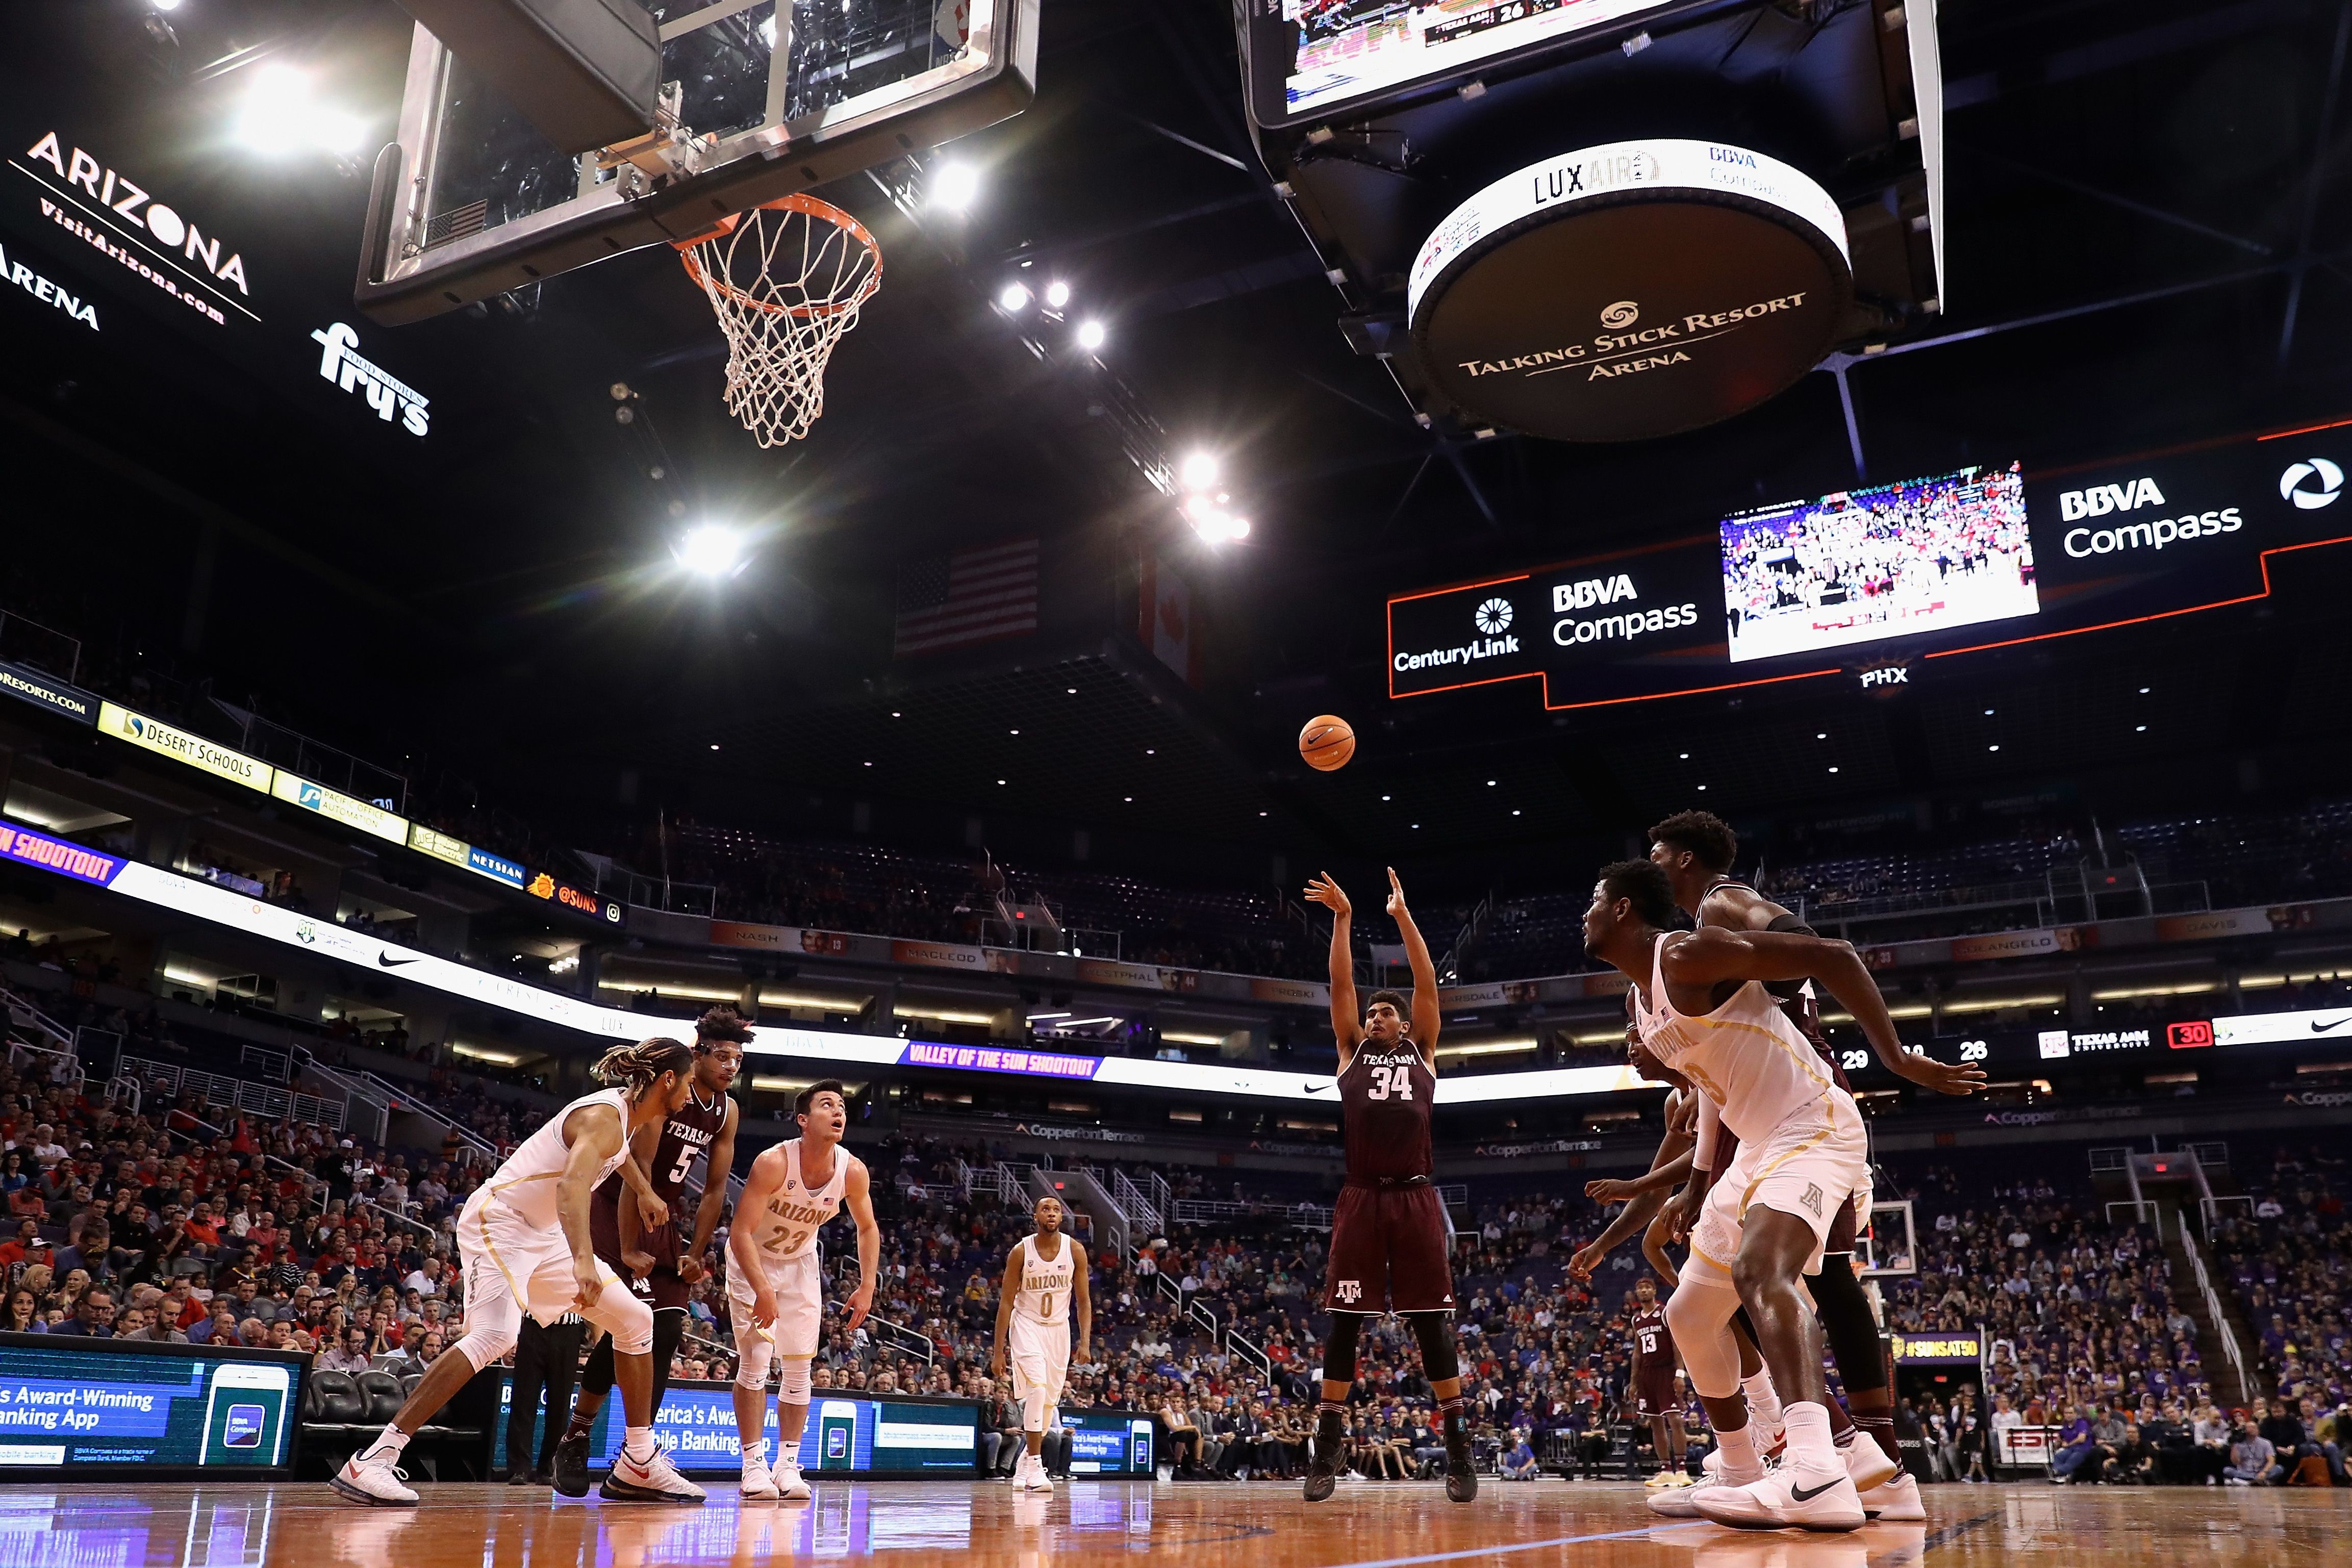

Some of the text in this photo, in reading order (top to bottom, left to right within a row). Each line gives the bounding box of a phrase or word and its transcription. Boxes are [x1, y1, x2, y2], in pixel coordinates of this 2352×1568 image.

[1500, 3, 1524, 22] 26
[27, 132, 248, 296] ARIZONA
[40, 197, 225, 325] VisitArizona.com
[1459, 291, 1807, 377] TALKING STICK RESORT
[310, 322, 430, 437] fry's
[343, 349, 424, 405] FOOD STORES
[1587, 351, 1692, 382] ARENA
[2060, 477, 2166, 522] BBVA
[2064, 508, 2242, 560] Compass
[1553, 574, 1637, 613] BBVA
[1553, 602, 1698, 646] Compass
[1394, 634, 1520, 672] CenturyLink
[1860, 668, 1909, 689] PHX
[147, 724, 195, 755] DESERT
[197, 745, 252, 777] SCHOOLS
[323, 802, 377, 827] AUTOMATION
[324, 791, 354, 809] PACIFIC
[357, 804, 384, 820] OFFICE
[13, 833, 114, 881] SHOOTOUT
[472, 853, 522, 879] NETSIAN
[559, 887, 597, 914] @SUNS
[736, 931, 778, 942] NASH
[907, 948, 975, 963] MACLEOD
[1449, 991, 1500, 1002] ARSDALE
[2072, 1032, 2117, 1047] TEXAS
[2179, 1025, 2207, 1043] 30
[909, 1044, 1095, 1076] VALLEY OF THE SUN SHOOTOUT
[1363, 1053, 1417, 1068] TEXAS A&M
[1842, 1050, 1868, 1070] 29
[1960, 1040, 1988, 1061] 26
[1368, 1067, 1413, 1101] 34
[667, 1120, 703, 1145] TEXAS
[669, 1145, 699, 1183] 5
[762, 1225, 810, 1255] 23
[1025, 1275, 1069, 1291] ARIZONA
[1041, 1292, 1053, 1318] 0
[1640, 1333, 1658, 1354] 13
[1906, 1340, 1978, 1357] #SUNSAT50
[15, 1386, 155, 1412] Award-Winning
[61, 1409, 99, 1430] App
[681, 1430, 740, 1455] Banking
